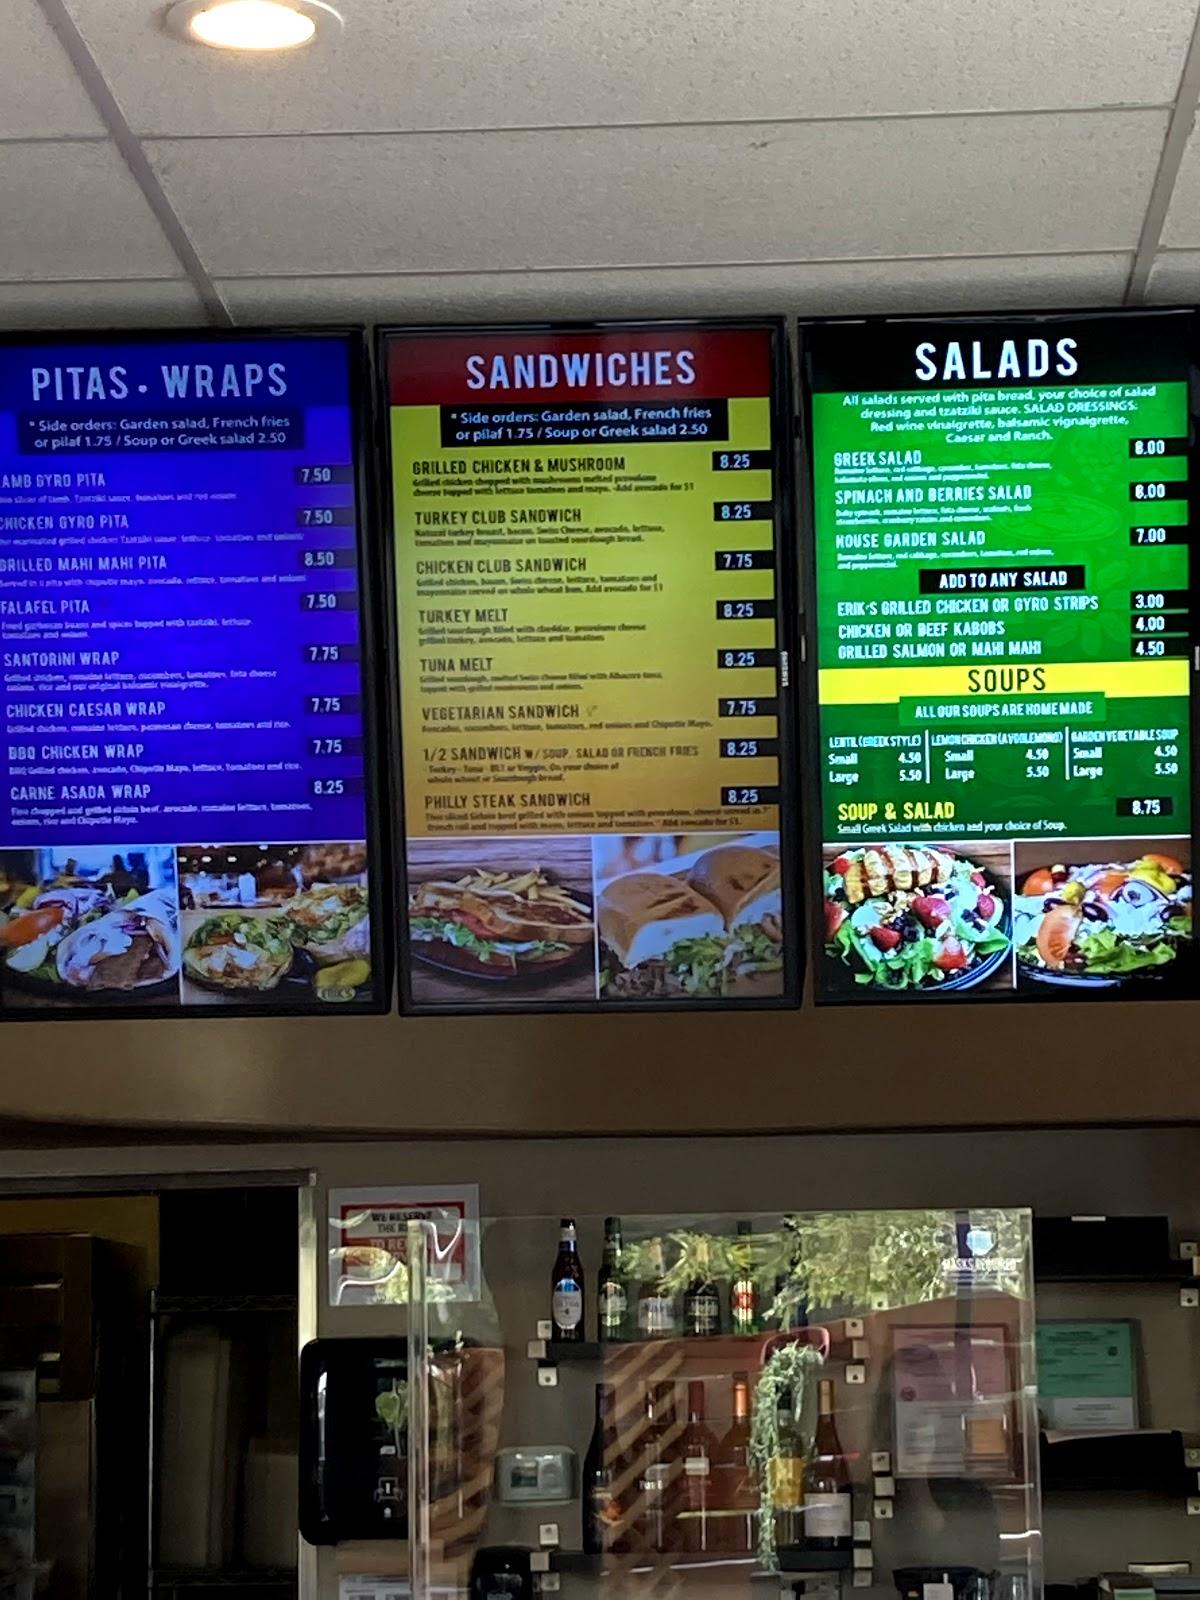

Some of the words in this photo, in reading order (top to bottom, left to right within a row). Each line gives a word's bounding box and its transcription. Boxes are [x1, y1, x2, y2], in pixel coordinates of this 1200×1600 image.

[915, 337, 1077, 380] SALADS
[466, 350, 695, 389] SANDWICHES
[32, 366, 128, 401] PITAS
[161, 363, 286, 398] WRAPS
[39, 419, 67, 431] Side
[119, 418, 168, 429] Garden
[213, 416, 258, 427] French
[261, 415, 289, 426] fries
[460, 411, 489, 424] Side
[541, 409, 590, 422] Garden
[634, 407, 680, 419] French
[683, 406, 711, 418] fries
[34, 439, 48, 448] or
[51, 435, 80, 449] pilaf
[85, 435, 111, 446] 1.75
[124, 434, 157, 447] Soup
[160, 436, 174, 445] or
[178, 433, 217, 445] Greek
[220, 432, 254, 444] salad
[258, 431, 286, 443] 2.50
[455, 431, 469, 440] or
[472, 427, 503, 442] pilaf
[506, 427, 534, 439] 1.75
[544, 426, 579, 440] Soup
[582, 428, 596, 437] or
[598, 424, 638, 437] Greek
[641, 423, 676, 436] salad
[679, 422, 707, 435] 2.50
[1134, 439, 1165, 455] 8.00
[412, 460, 466, 475] GRILLED
[472, 458, 529, 474] CHICKEN
[534, 458, 543, 472] &
[547, 456, 625, 472] MUSHROOM
[719, 453, 749, 468] 8.25
[834, 451, 876, 467] GREEK
[878, 449, 921, 465] SALAD
[0, 473, 31, 488] AMB
[36, 473, 70, 487] GYRO
[76, 472, 105, 486] PITA
[301, 467, 330, 482] 7.50
[835, 488, 892, 504] SPINACH
[896, 487, 923, 502] AND
[928, 485, 984, 502] BERRIES
[988, 484, 1031, 500] SALAD
[303, 509, 332, 524] 7.50
[414, 510, 467, 525] TURKEY
[471, 510, 505, 524] CLUB
[510, 508, 581, 523] SANDWICH
[721, 504, 751, 519] 8.25
[59, 514, 94, 529] GYRO
[99, 514, 128, 528] PITA
[835, 533, 878, 548] HOUSE
[884, 531, 936, 547] GARDEN
[941, 530, 985, 545] SALAD
[1136, 527, 1166, 543] 7.00
[58, 557, 92, 571] MAHI
[98, 556, 132, 570] MAHI
[138, 555, 166, 569] PITA
[304, 551, 334, 566] 8.50
[416, 559, 473, 575] CHICKEN
[477, 559, 511, 573] CLUB
[516, 557, 586, 572] SANDWICH
[723, 552, 752, 568] 7.75
[939, 573, 966, 588] ADD
[969, 572, 986, 588] TO
[989, 572, 1017, 587] ANY
[1023, 570, 1067, 586] SALAD
[0, 599, 55, 614] FALAFEL
[60, 599, 89, 613] PITA
[306, 593, 336, 608] 7.50
[881, 599, 931, 615] GRILLED
[936, 598, 988, 614] CHICKEN
[992, 597, 1009, 612] OR
[1014, 596, 1048, 611] GYRO
[1054, 595, 1098, 610] STRIPS
[1135, 593, 1164, 609] 3.00
[418, 609, 470, 623] TURKEY
[475, 608, 507, 622] MELT
[723, 602, 753, 618] 8.25
[838, 623, 891, 639] CHICKEN
[895, 622, 912, 637] OR
[917, 622, 948, 637] BEEF
[953, 620, 1005, 636] KABOBS
[1135, 615, 1164, 631] 4.00
[310, 645, 338, 661] 7.75
[838, 643, 887, 659] GRILLED
[892, 642, 944, 658] SALMON
[949, 642, 966, 657] OR
[971, 641, 1004, 656] MAHI
[1008, 640, 1041, 655] MAHI
[1135, 640, 1164, 655] 4.50
[4, 651, 75, 667] SANTORINI
[79, 651, 119, 665] WRAP
[419, 657, 455, 672] TUNA
[459, 657, 492, 672] MELT
[724, 651, 754, 666] 8.25
[968, 667, 1045, 695] SOUPS
[6, 703, 63, 718] CHICKEN
[68, 702, 121, 717] CAESAR
[126, 701, 165, 715] WRAP
[311, 696, 340, 712] 7.75
[422, 705, 504, 720] VEGETARIAN
[508, 704, 579, 719] SANDWICH
[726, 699, 756, 715] 7.75
[8, 746, 35, 760] BBQ
[41, 744, 98, 759] CHICKEN
[104, 743, 143, 758] WRAP
[313, 738, 342, 754] 7.75
[422, 747, 446, 762] 1/2
[450, 746, 521, 761] SANDWICH
[727, 740, 757, 756] 8.25
[1025, 748, 1049, 760] 4.50
[1072, 746, 1102, 759] Small
[1154, 744, 1178, 757] 4.50
[828, 752, 858, 765] Small
[898, 751, 921, 763] 4.50
[944, 749, 973, 762] Small
[899, 768, 922, 781] 5.50
[945, 767, 975, 782] Large
[1026, 765, 1049, 777] 5.50
[1073, 764, 1102, 779] Large
[1155, 762, 1178, 774] 5.50
[829, 770, 859, 785] Large
[10, 785, 53, 800] CARNE
[61, 784, 105, 799] ASADA
[111, 783, 150, 799] WRAP
[314, 779, 343, 794] 8.25
[424, 794, 467, 809] PHILLY
[473, 793, 515, 808] STEAK
[520, 792, 590, 807] SANDWICH
[728, 788, 758, 804] 8.25
[837, 802, 877, 821] SOUP
[884, 802, 896, 820] &
[903, 801, 954, 819] SALAD
[1132, 798, 1160, 815] 8.75
